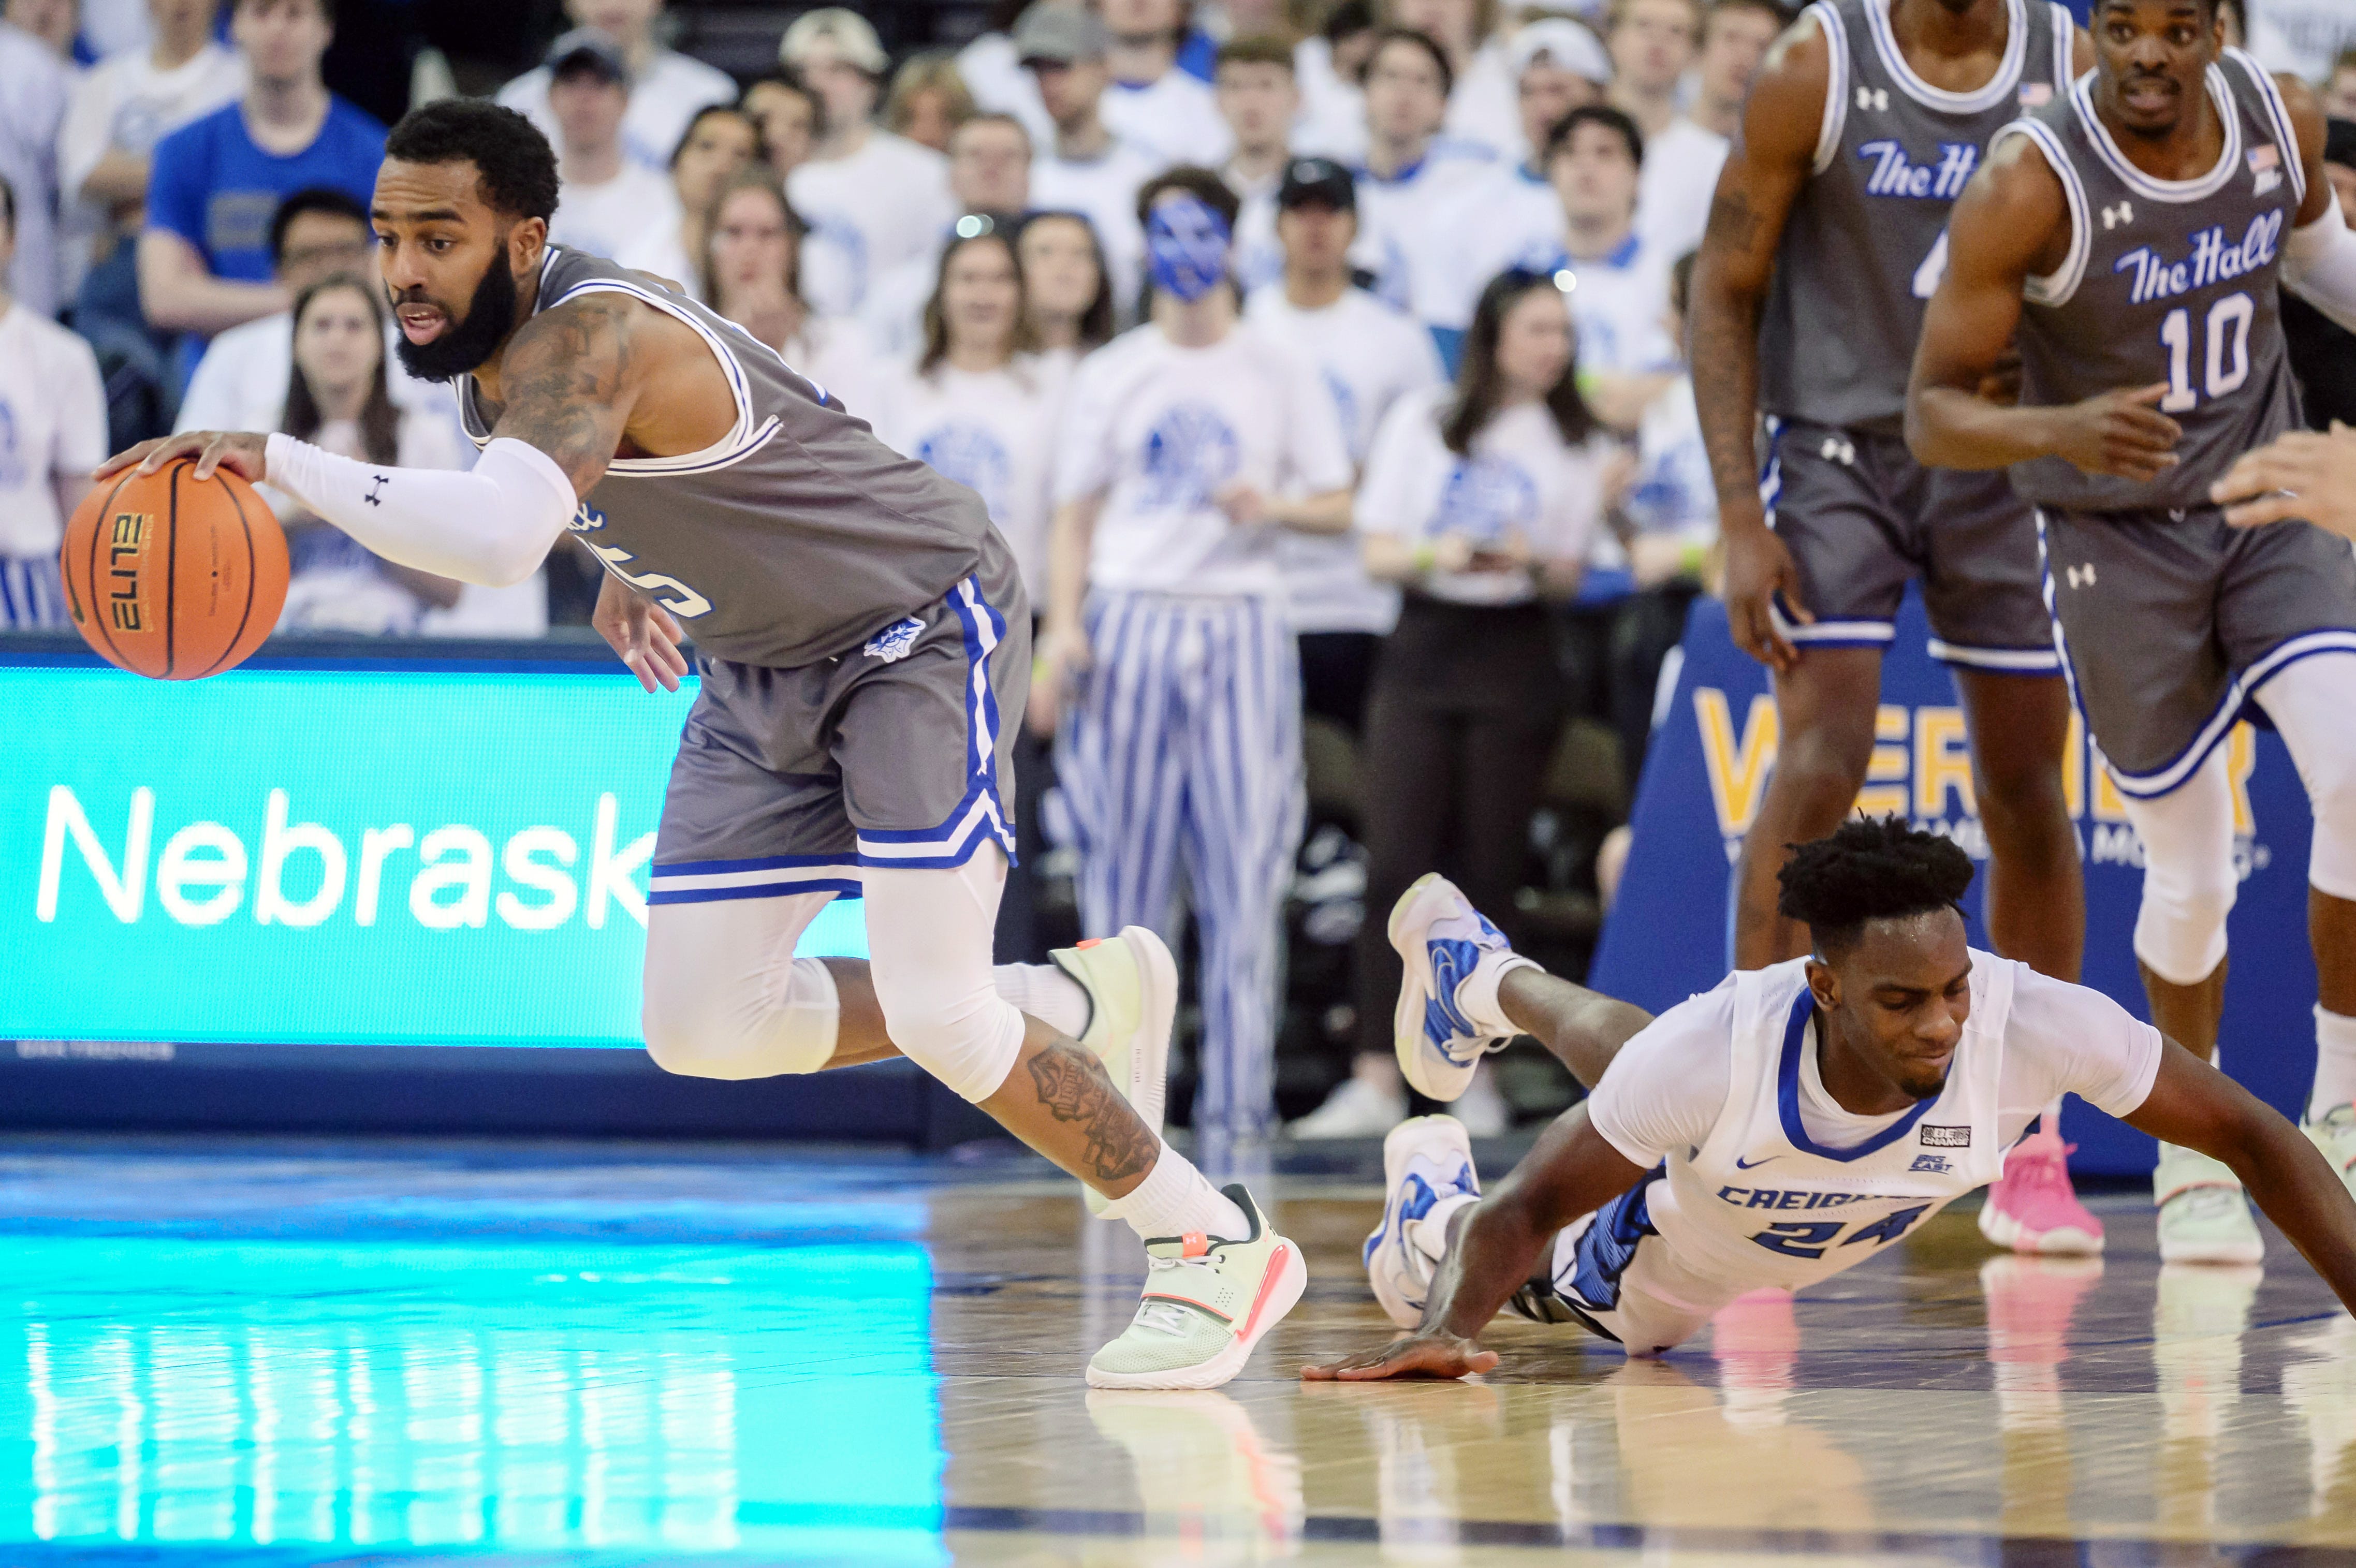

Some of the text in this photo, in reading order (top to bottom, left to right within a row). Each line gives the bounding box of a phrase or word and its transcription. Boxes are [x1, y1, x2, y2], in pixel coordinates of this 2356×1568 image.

[1857, 139, 1933, 198] The
[2113, 208, 2284, 304] The Hall
[2160, 291, 2255, 413] 10
[110, 513, 144, 632] ELITE
[36, 784, 658, 931] Nebrask
[1744, 1203, 1935, 1259] 24
